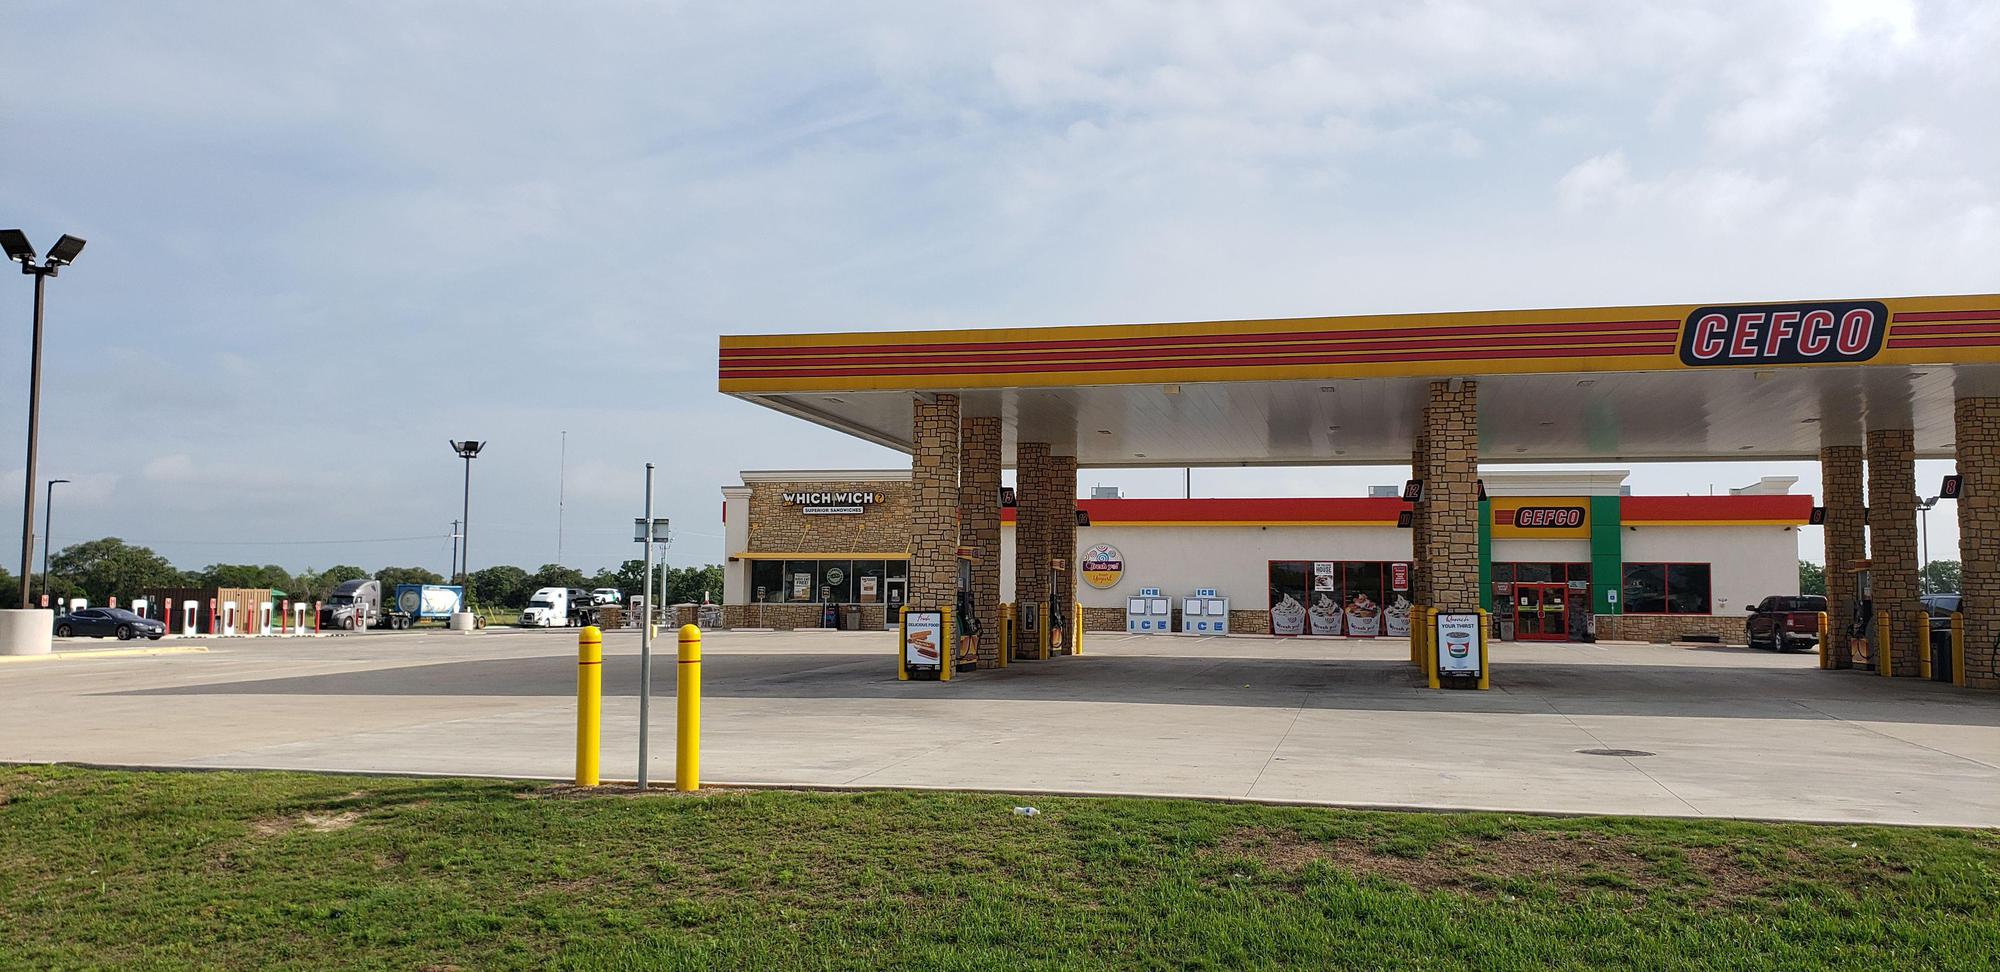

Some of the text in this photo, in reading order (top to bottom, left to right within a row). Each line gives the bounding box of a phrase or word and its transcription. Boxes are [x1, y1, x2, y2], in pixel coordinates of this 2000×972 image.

[1692, 308, 1875, 359] CEFCO
[1405, 483, 1420, 498] 12
[1945, 479, 1956, 495] 8
[782, 492, 831, 504] WHICH
[835, 492, 873, 504] WICH
[1003, 490, 1014, 504] 15
[1520, 509, 1580, 526] CEFCO
[1130, 620, 1167, 630] ICE
[1186, 621, 1223, 631] ICE
